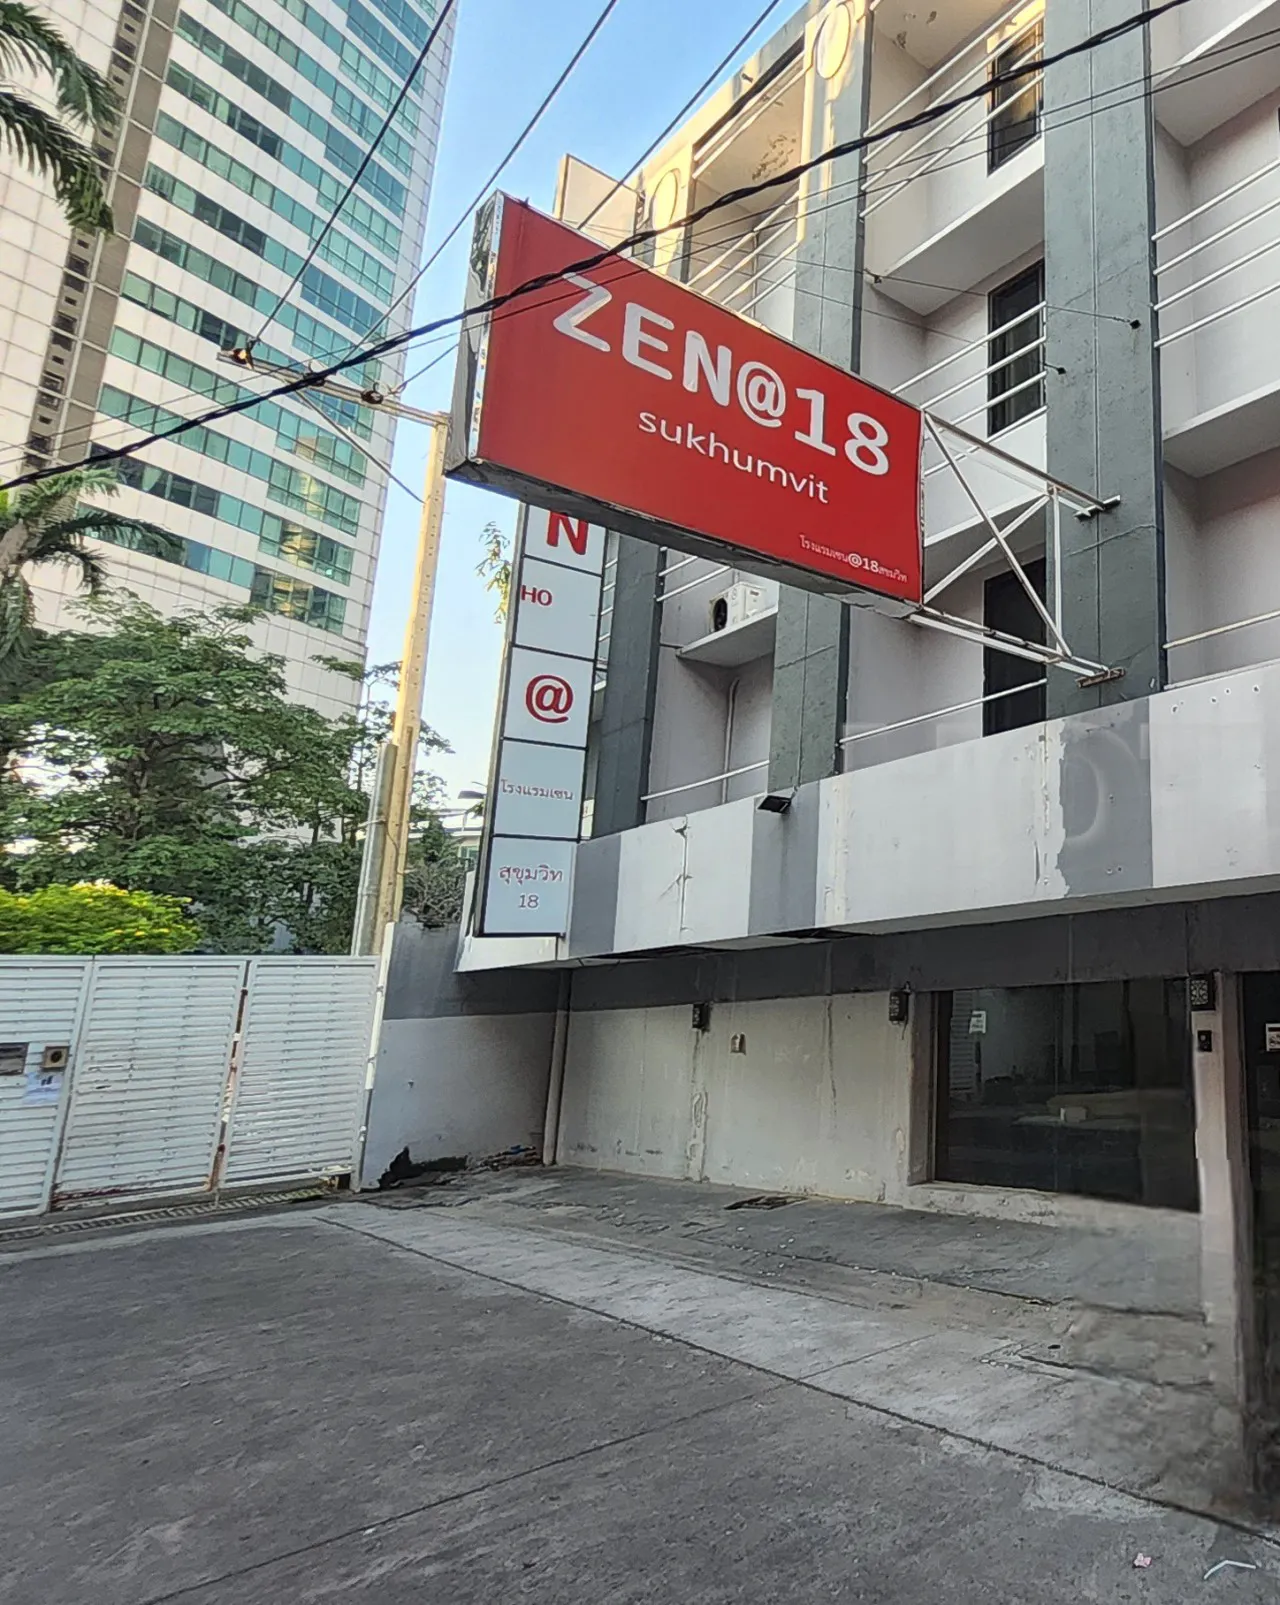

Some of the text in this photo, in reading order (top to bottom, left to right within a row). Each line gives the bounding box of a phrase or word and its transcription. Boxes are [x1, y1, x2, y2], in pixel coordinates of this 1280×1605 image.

[552, 270, 890, 476] ZEN@18
[637, 409, 830, 505] sukhumvit
[546, 510, 589, 556] N
[499, 863, 564, 885] สุขุมวิท
[518, 894, 540, 909] 18
